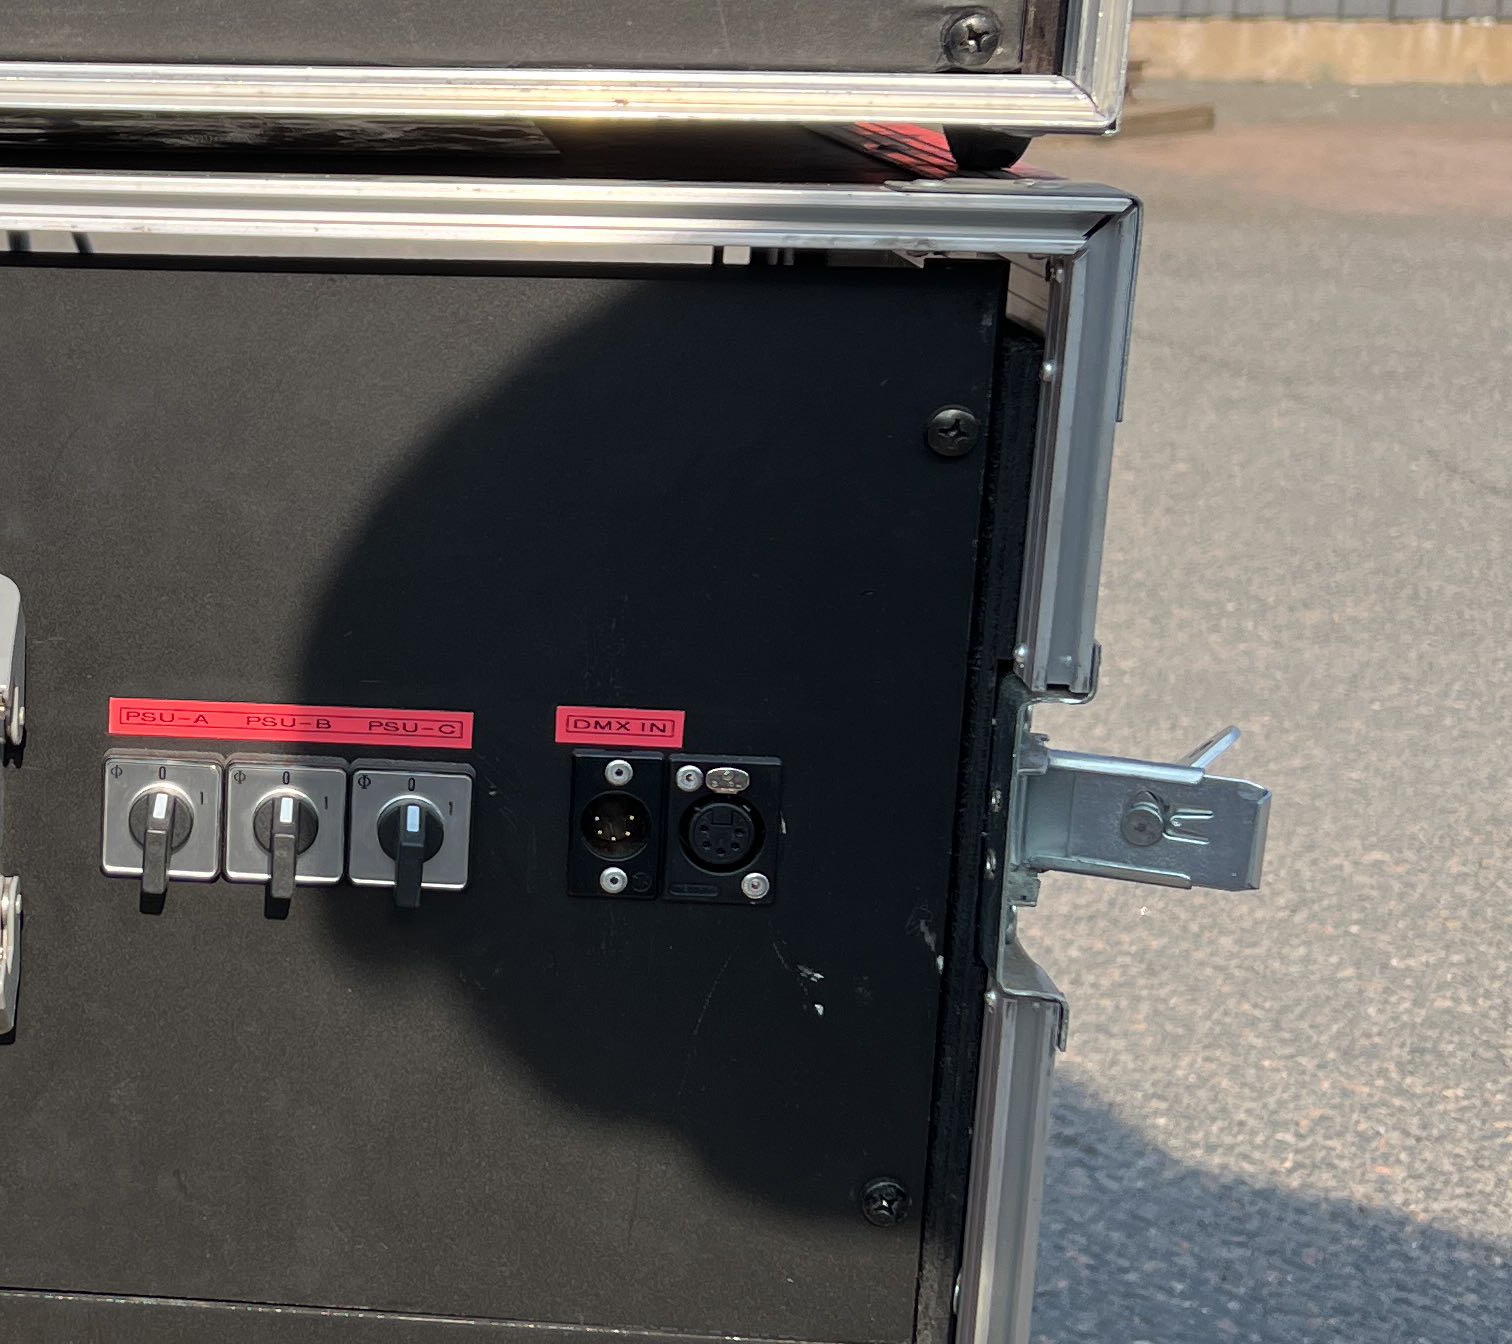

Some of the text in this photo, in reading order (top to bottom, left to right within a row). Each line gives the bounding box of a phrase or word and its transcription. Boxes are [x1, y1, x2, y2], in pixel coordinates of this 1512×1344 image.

[125, 711, 456, 736] PSU-A PSU-B PSU-C
[573, 718, 666, 734] DMX IN
